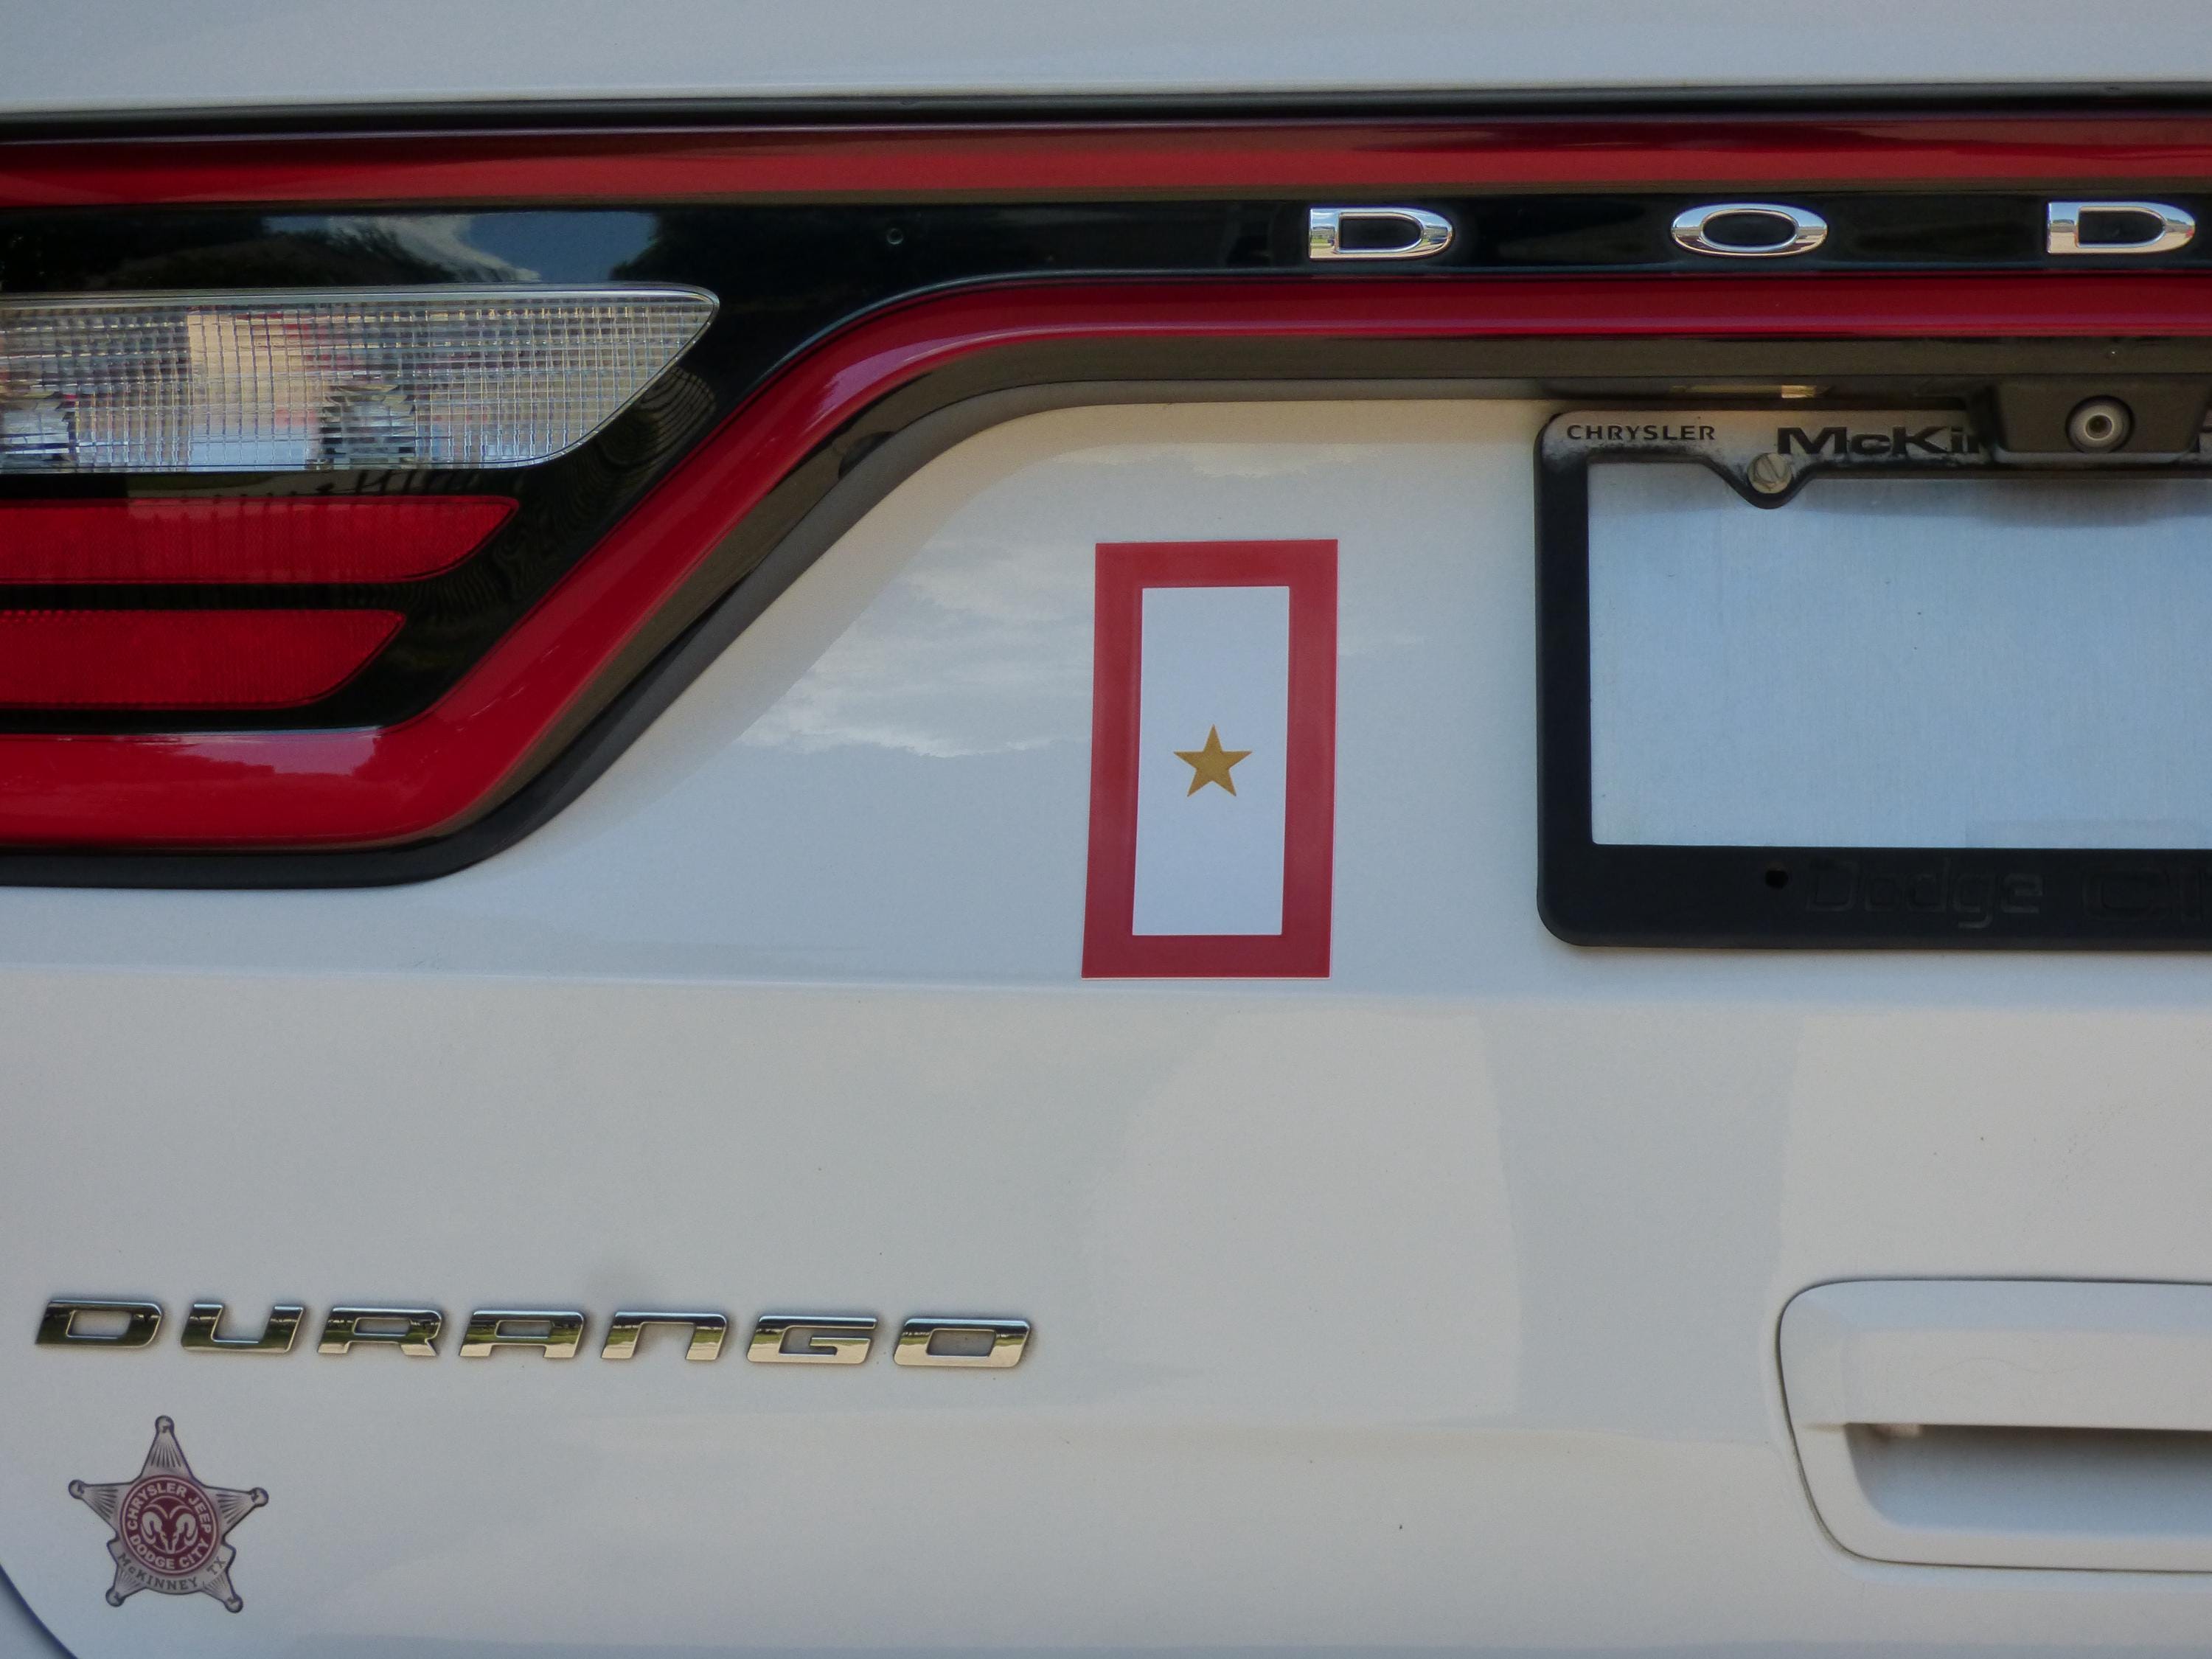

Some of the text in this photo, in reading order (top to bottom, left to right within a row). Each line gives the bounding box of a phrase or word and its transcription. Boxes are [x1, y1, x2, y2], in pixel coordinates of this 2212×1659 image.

[1566, 424, 1717, 441] CHRYSLER
[1805, 857, 2044, 930] Dodge
[35, 1299, 1031, 1368] DURANGO
[127, 1482, 212, 1534] CHRYSLER JEEP
[130, 1534, 209, 1570] DODGE CITY
[206, 1556, 226, 1576] TX
